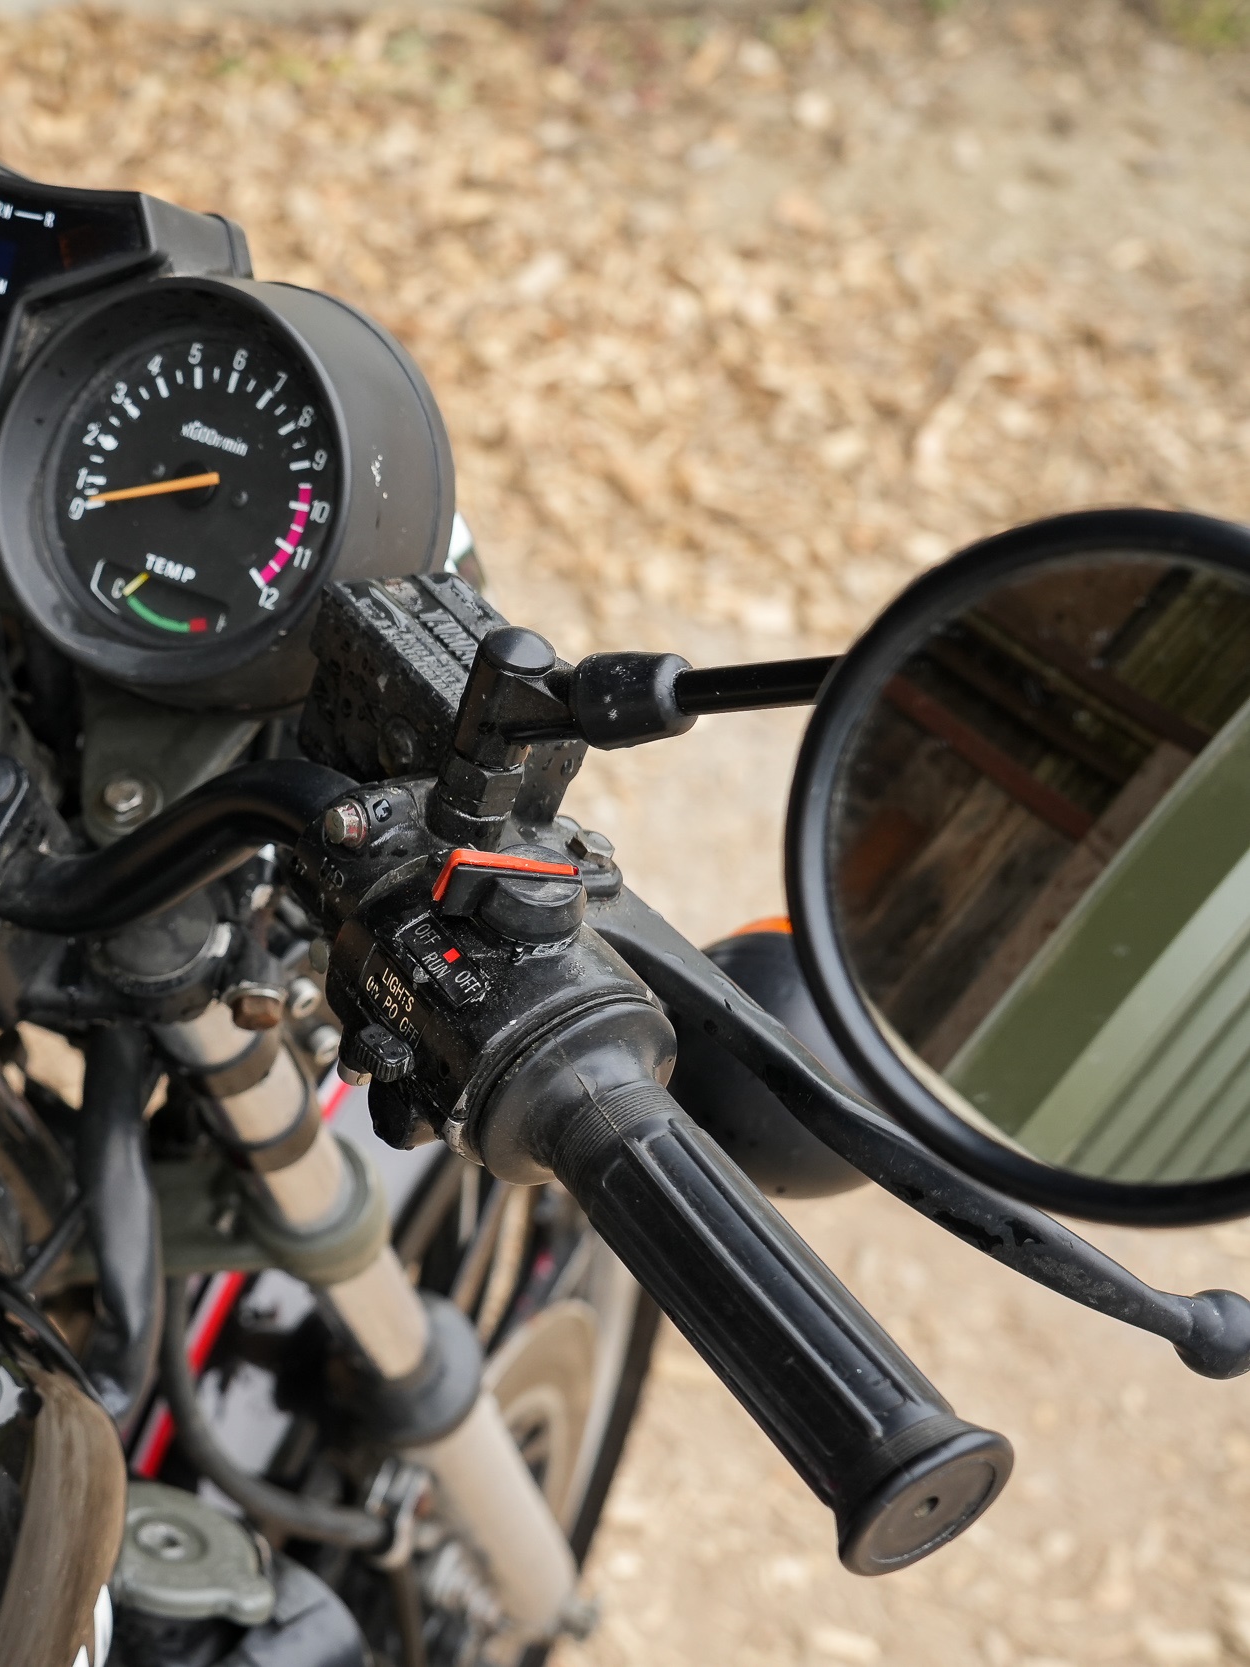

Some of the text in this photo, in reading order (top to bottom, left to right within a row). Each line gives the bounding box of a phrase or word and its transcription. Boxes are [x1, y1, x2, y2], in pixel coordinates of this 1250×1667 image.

[147, 354, 163, 376] 4
[188, 342, 203, 364] 5
[233, 349, 248, 371] 6
[111, 381, 127, 404] 3
[273, 371, 289, 394] 7
[299, 405, 315, 428] 8
[82, 421, 101, 447] 2
[312, 449, 328, 471] 9
[75, 467, 89, 491] 1
[67, 497, 85, 521] 0
[308, 500, 331, 524] 10
[145, 553, 196, 583] TEMP
[292, 546, 312, 570] 11
[257, 586, 279, 610] 12
[414, 923, 442, 945] OFF
[421, 951, 452, 979] RUN
[381, 967, 415, 1012] LIGHTS
[454, 970, 482, 993] OFF
[382, 995, 399, 1019] PO
[399, 1017, 419, 1042] OFF
